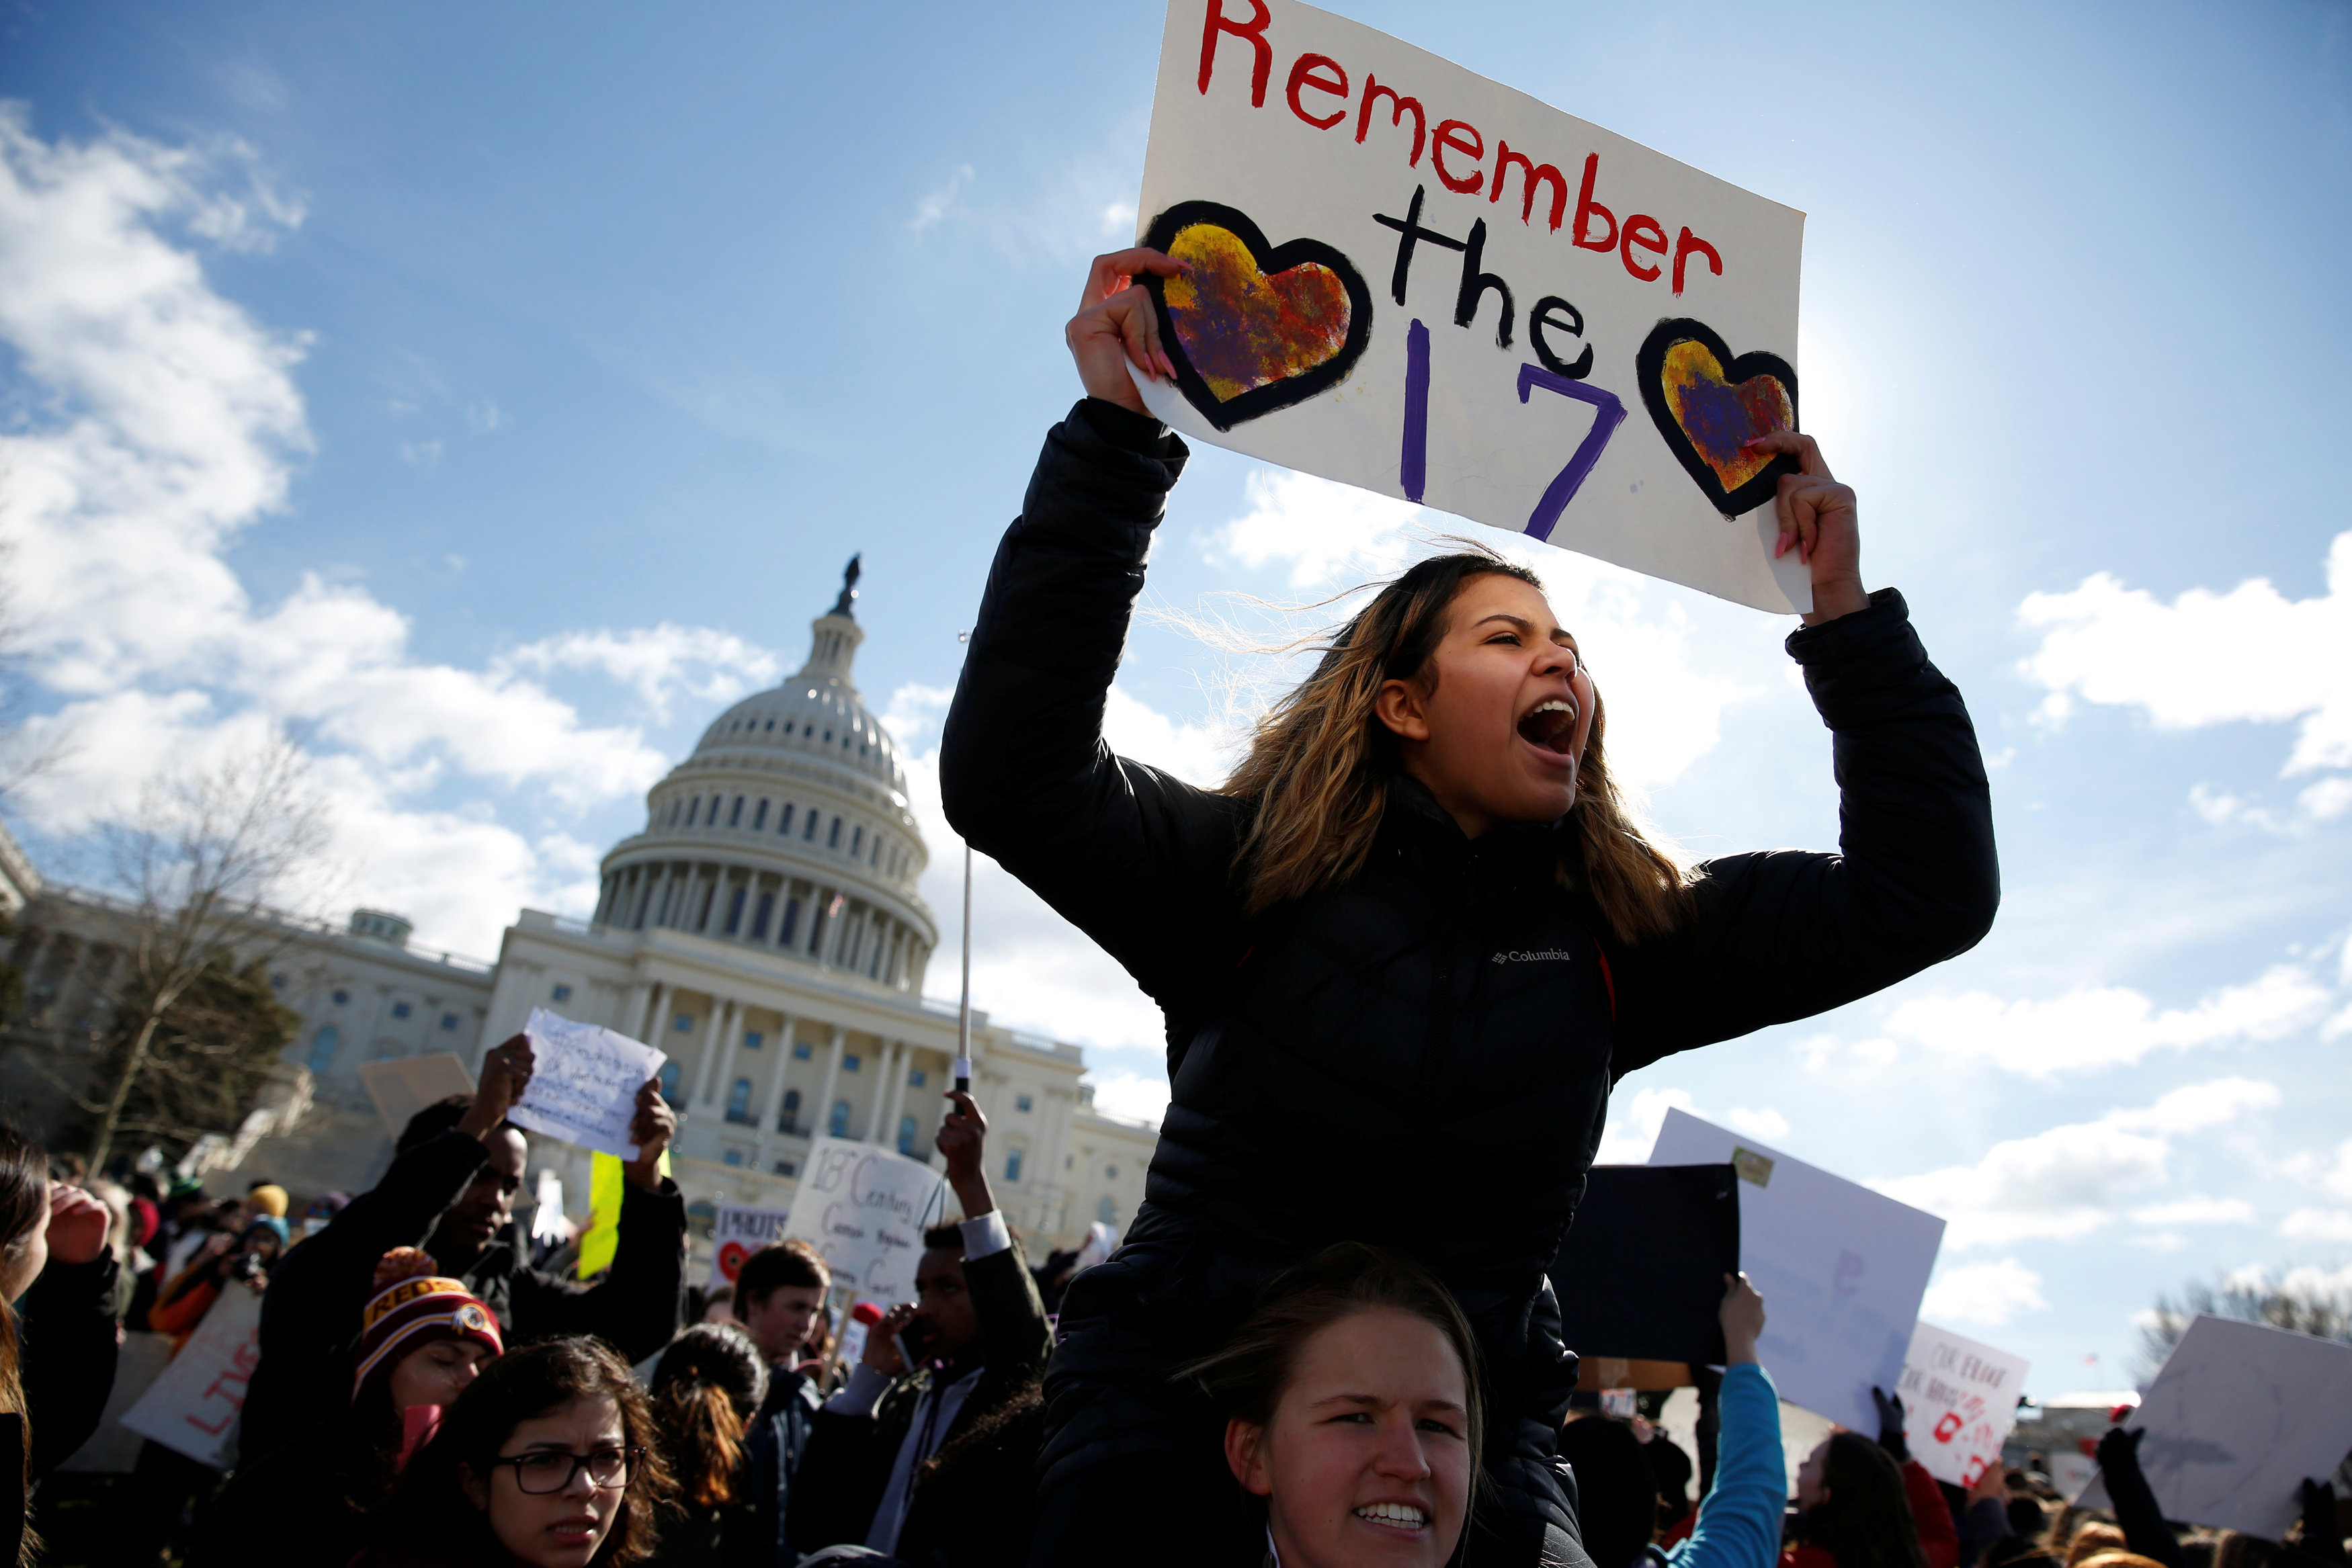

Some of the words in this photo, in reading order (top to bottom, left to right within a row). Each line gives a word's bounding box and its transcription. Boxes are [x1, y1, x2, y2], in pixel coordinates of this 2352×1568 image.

[1198, 0, 1722, 297] Remember
[1373, 185, 1593, 379] the
[1400, 318, 1627, 542] 17
[1509, 948, 1570, 961] Columbia
[850, 1154, 913, 1224] Century
